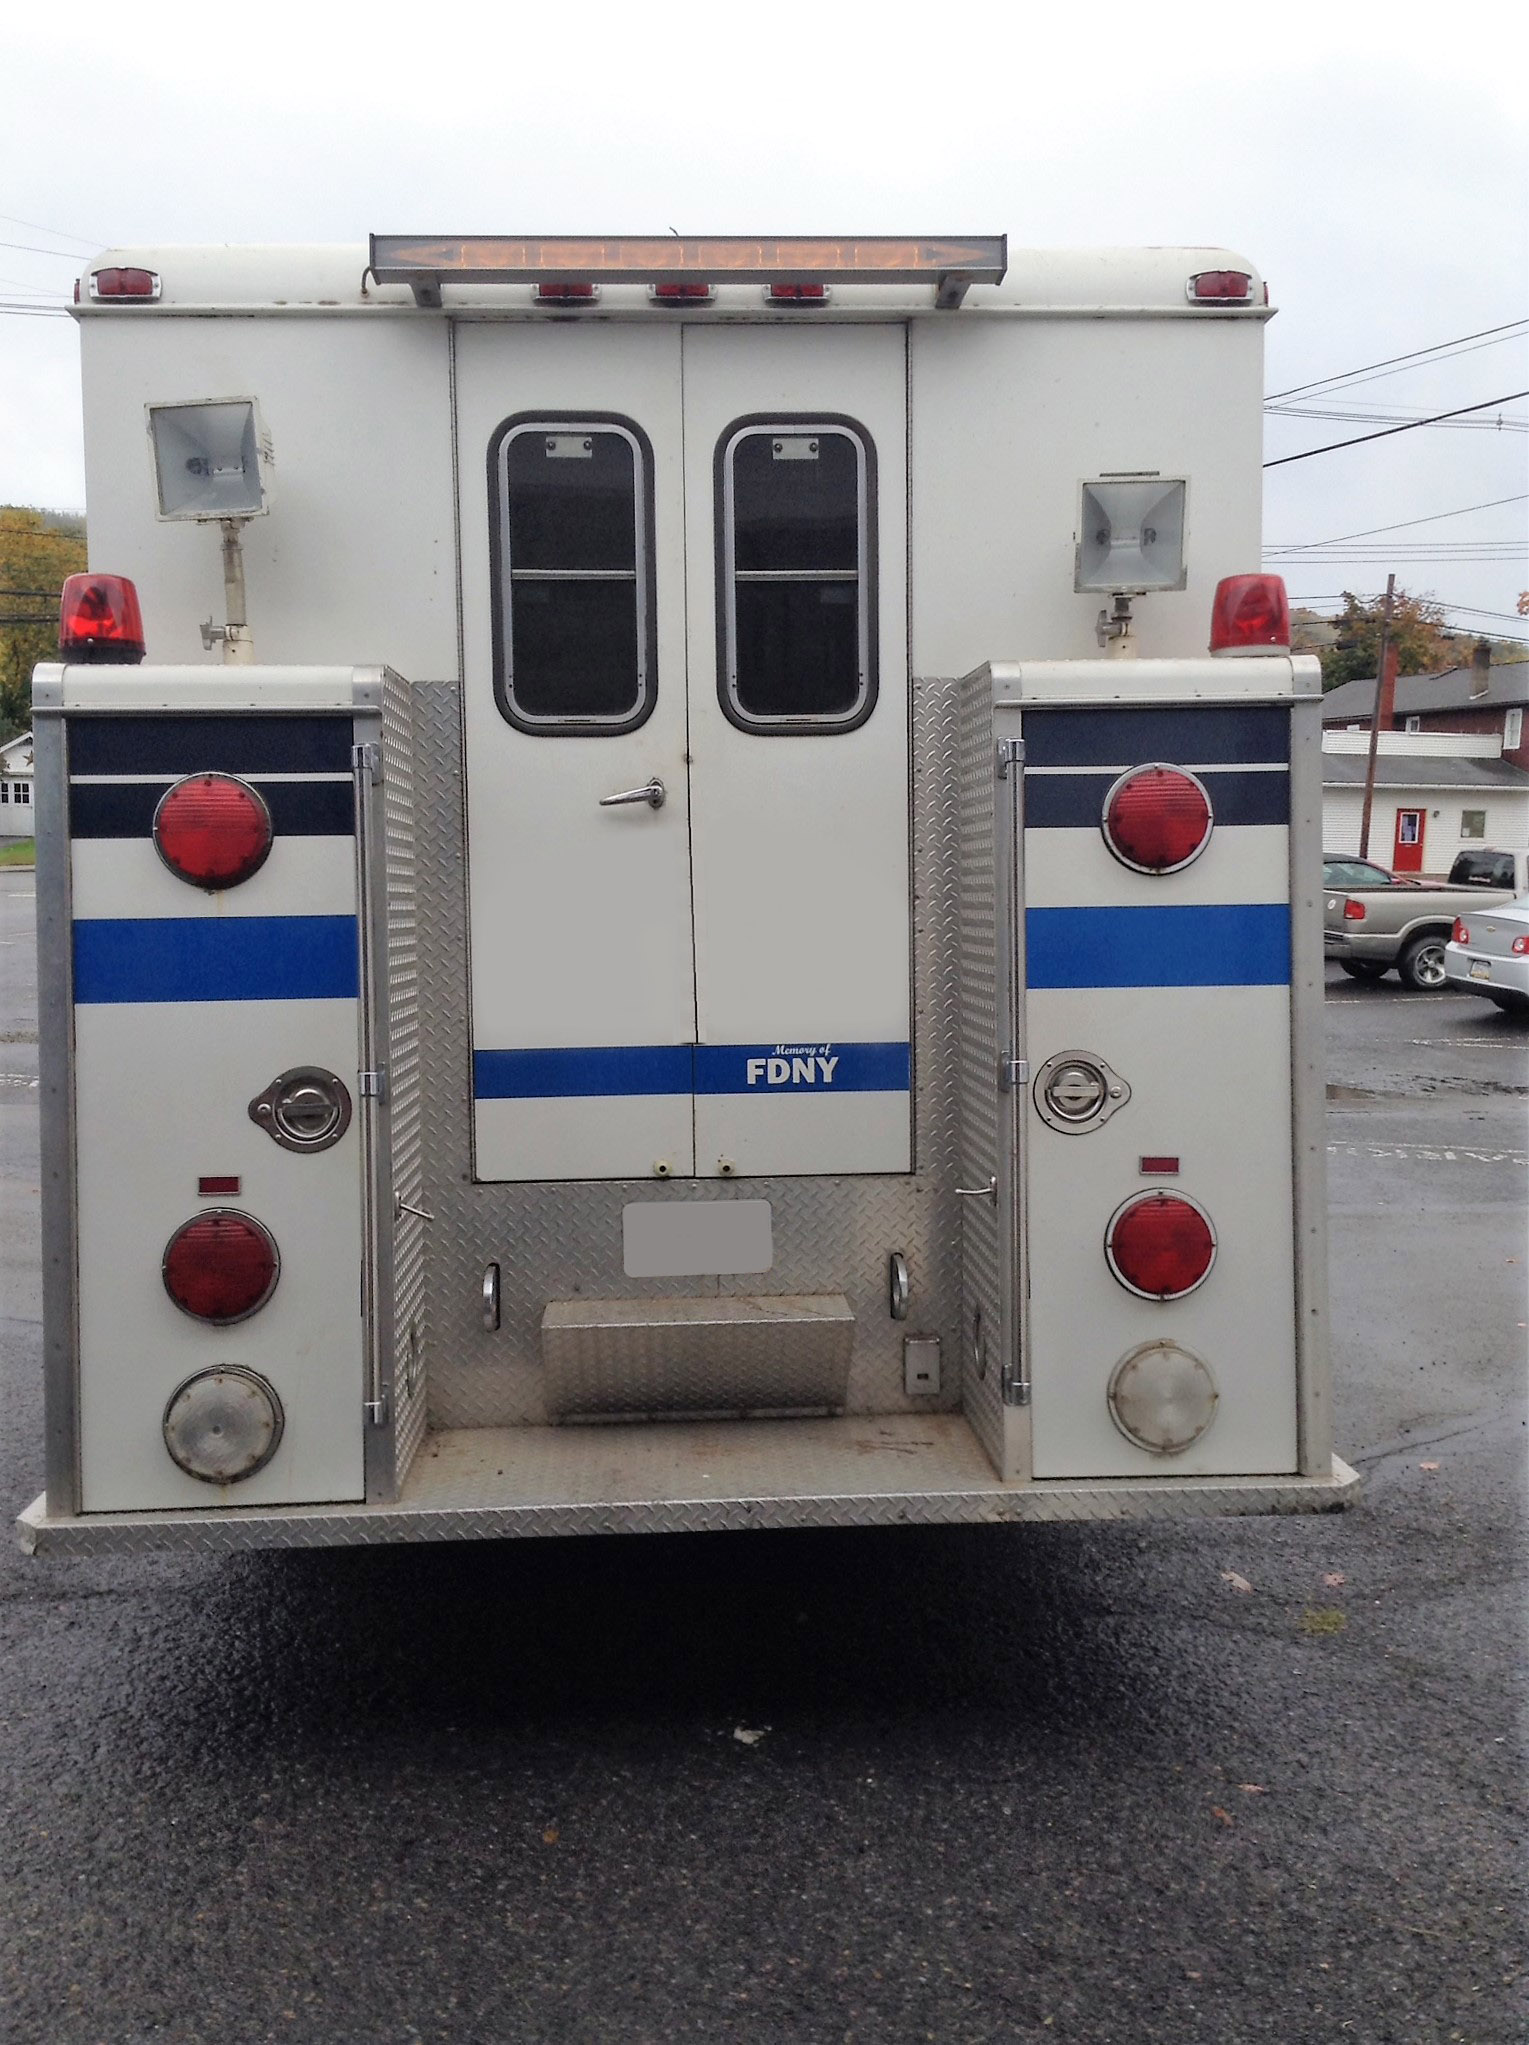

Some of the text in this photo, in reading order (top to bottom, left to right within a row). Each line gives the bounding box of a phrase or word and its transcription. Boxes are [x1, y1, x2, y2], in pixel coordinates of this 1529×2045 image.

[771, 1043, 832, 1057] Memory of
[746, 1056, 839, 1085] FDNY
